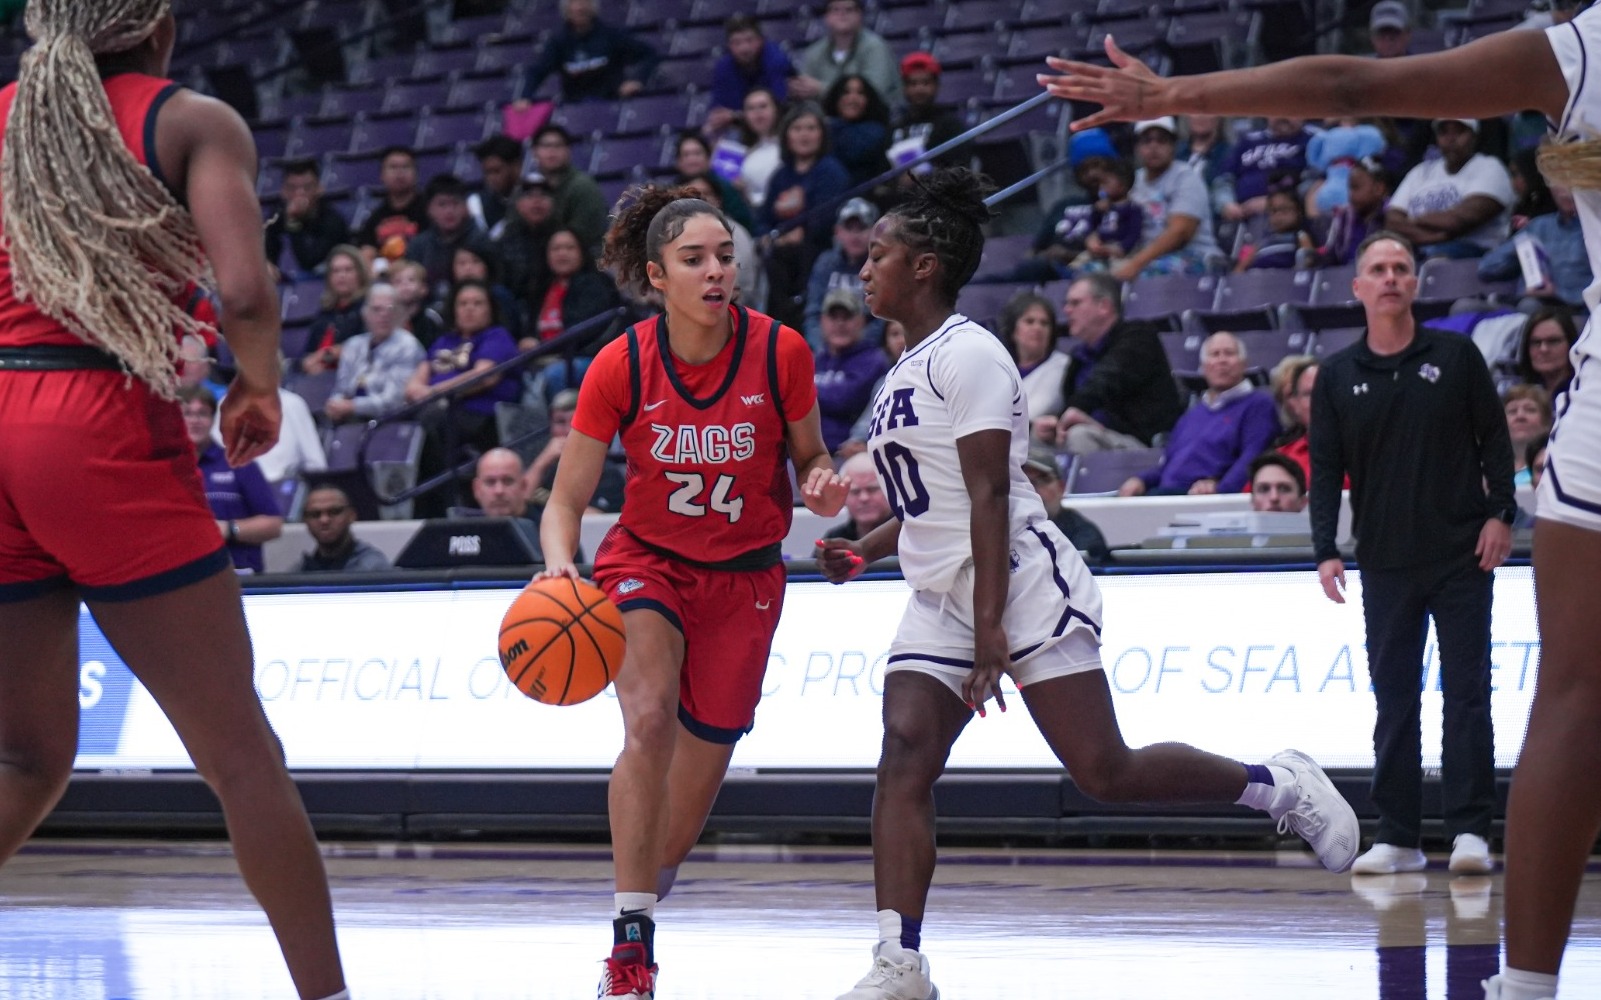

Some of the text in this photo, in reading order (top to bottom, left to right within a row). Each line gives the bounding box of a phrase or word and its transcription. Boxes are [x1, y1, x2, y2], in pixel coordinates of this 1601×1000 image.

[740, 393, 765, 405] WCC
[650, 422, 755, 464] ZAGS
[664, 469, 744, 523] 24
[873, 441, 930, 522] 10
[257, 657, 450, 700] OFFICIAL
[1111, 645, 1191, 693] OF
[1200, 644, 1301, 693] SFA
